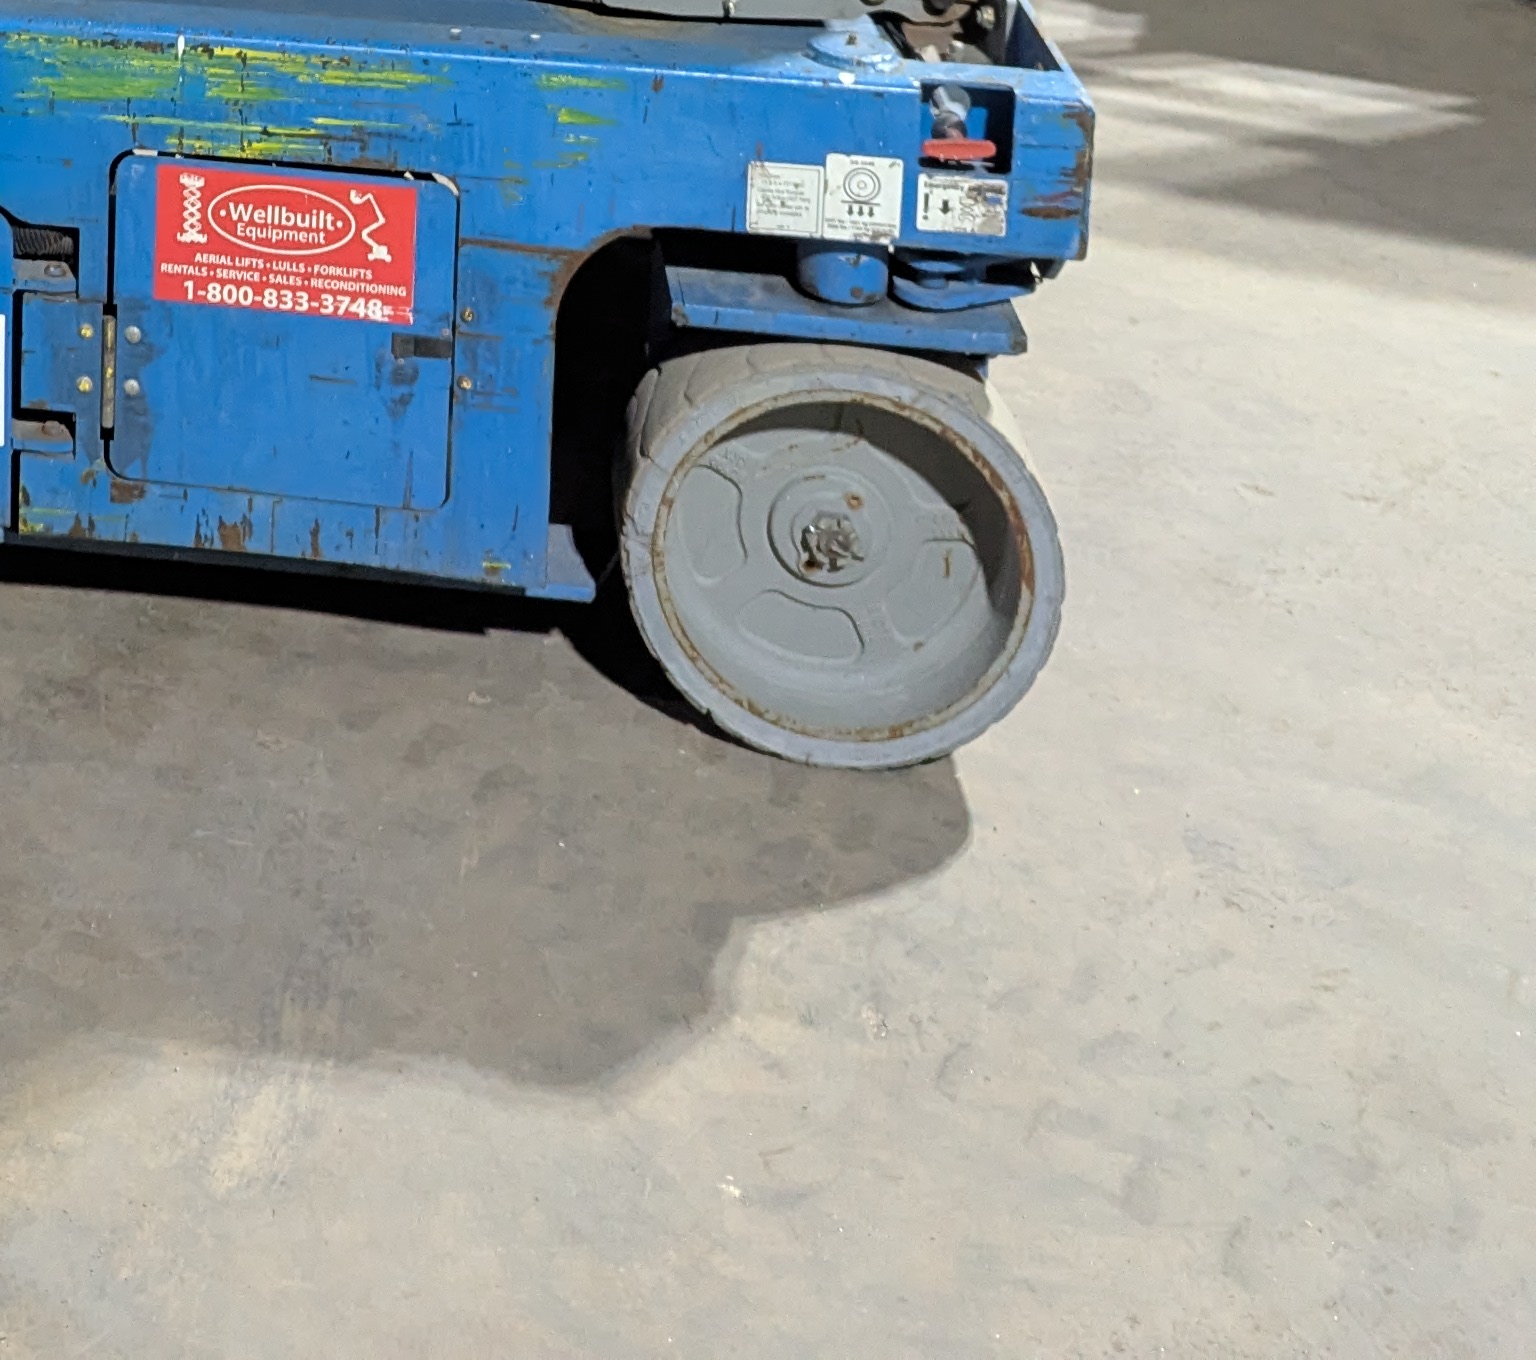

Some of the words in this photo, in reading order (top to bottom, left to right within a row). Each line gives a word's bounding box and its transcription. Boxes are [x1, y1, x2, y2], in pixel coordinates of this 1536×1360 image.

[229, 202, 335, 231] Wellbuilt
[237, 224, 326, 245] Equipment
[160, 263, 208, 277] RENTALS
[216, 268, 260, 282] SERVICE
[268, 273, 302, 286] SALES
[311, 278, 406, 296] RECONDITIONING
[194, 252, 233, 266] AERIAL
[235, 256, 264, 269] LIFTS
[272, 261, 305, 273] LULLS
[314, 264, 372, 280] FORKLIFTS
[183, 280, 383, 320] 1-800-833-3748
